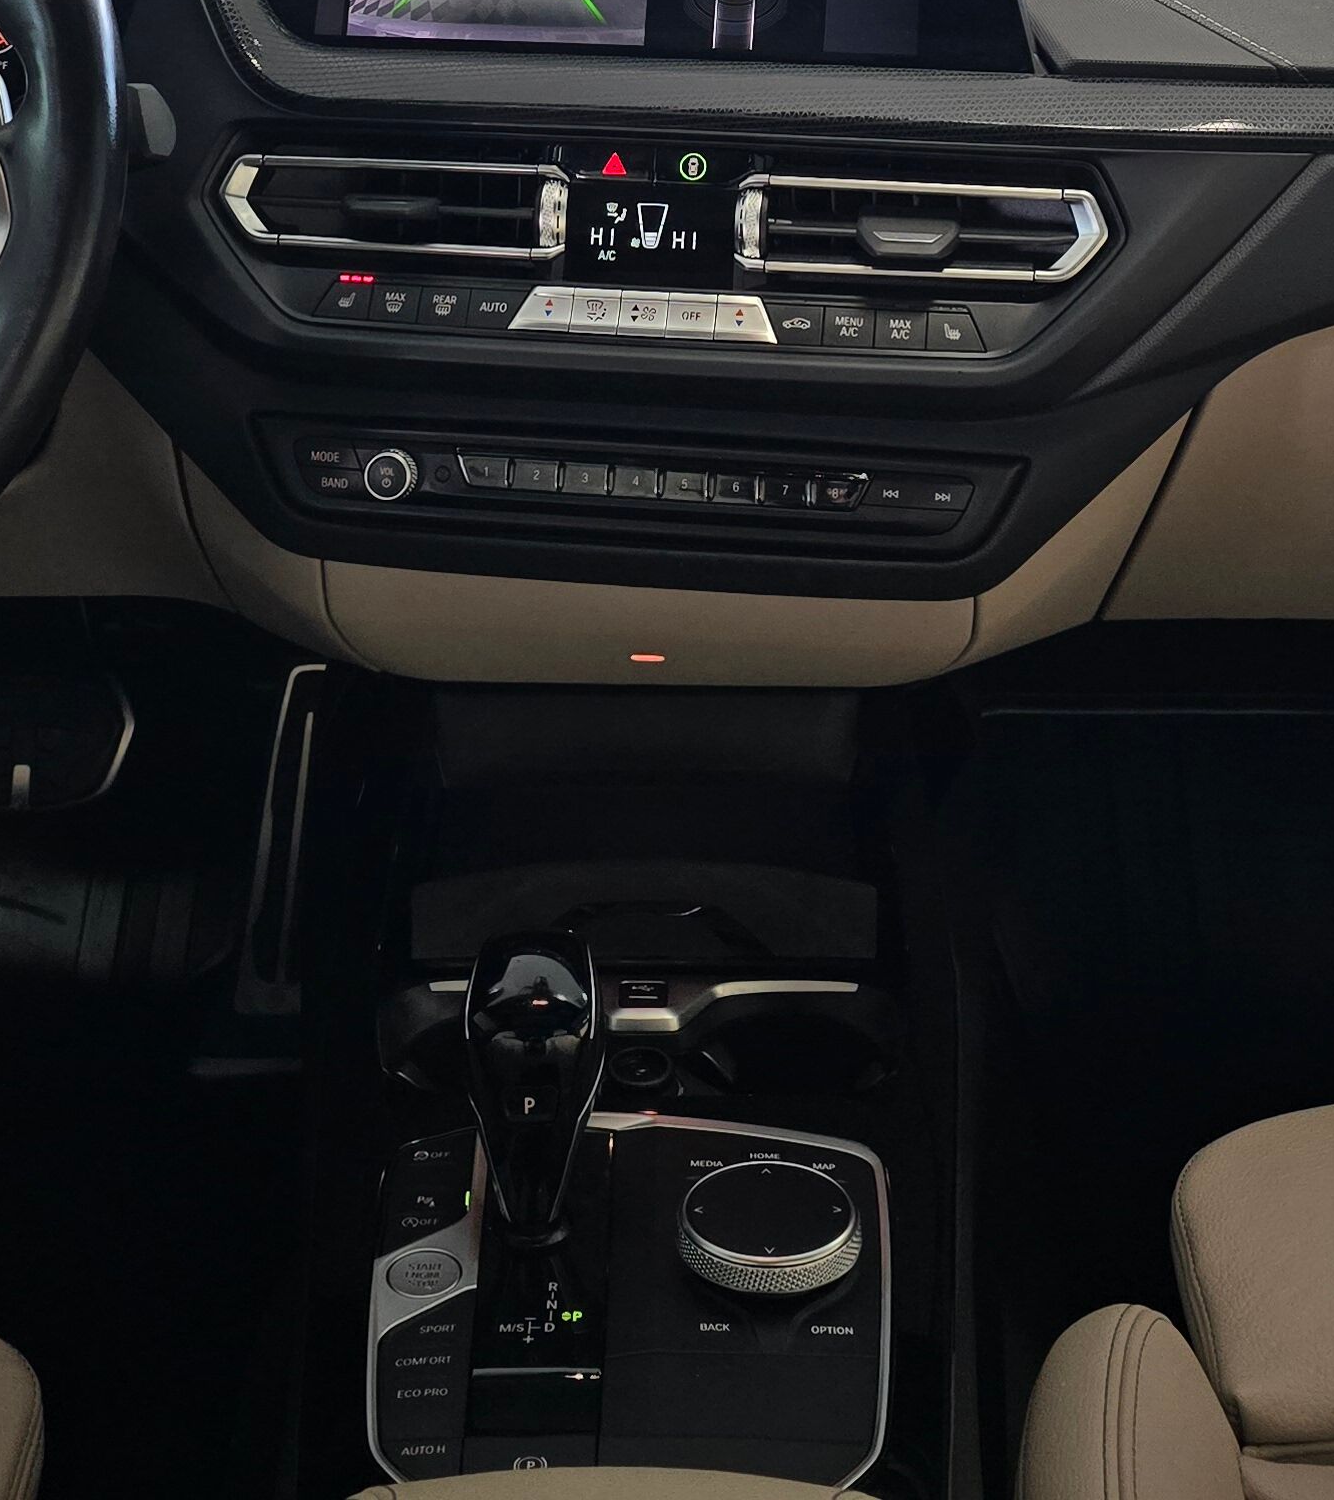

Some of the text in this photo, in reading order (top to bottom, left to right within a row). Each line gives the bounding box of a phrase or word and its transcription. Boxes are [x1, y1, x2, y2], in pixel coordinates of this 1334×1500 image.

[597, 250, 617, 262] A/C
[384, 291, 407, 303] MAX
[432, 294, 457, 306] REAR
[478, 301, 508, 314] AUTO
[681, 311, 701, 322] OFF
[835, 315, 864, 328] MENU
[889, 318, 912, 330] MAX
[839, 326, 859, 339] A/C
[890, 330, 911, 342] A/C
[310, 450, 340, 463] MODE
[379, 466, 395, 477] VOL
[532, 469, 540, 481] 2
[320, 476, 349, 490] BAND
[580, 472, 588, 484] 3
[631, 475, 640, 487] 4
[680, 478, 688, 490] 5
[732, 481, 740, 494] 6
[781, 484, 789, 496] 7
[523, 1096, 536, 1115] P
[749, 1152, 781, 1161] HOME
[689, 1159, 724, 1169] MEDIA
[812, 1162, 836, 1171] MAP
[407, 1262, 443, 1271] START
[548, 1281, 559, 1292] R
[546, 1299, 558, 1310] N
[572, 1310, 584, 1322] P
[418, 1323, 457, 1334] SPORT
[498, 1322, 556, 1334] M/S D
[699, 1322, 731, 1333] BACK
[810, 1324, 855, 1336] OPTION
[394, 1355, 452, 1367] COMFORT
[396, 1387, 449, 1399] ECO PRO
[400, 1444, 446, 1457] AUTO H
